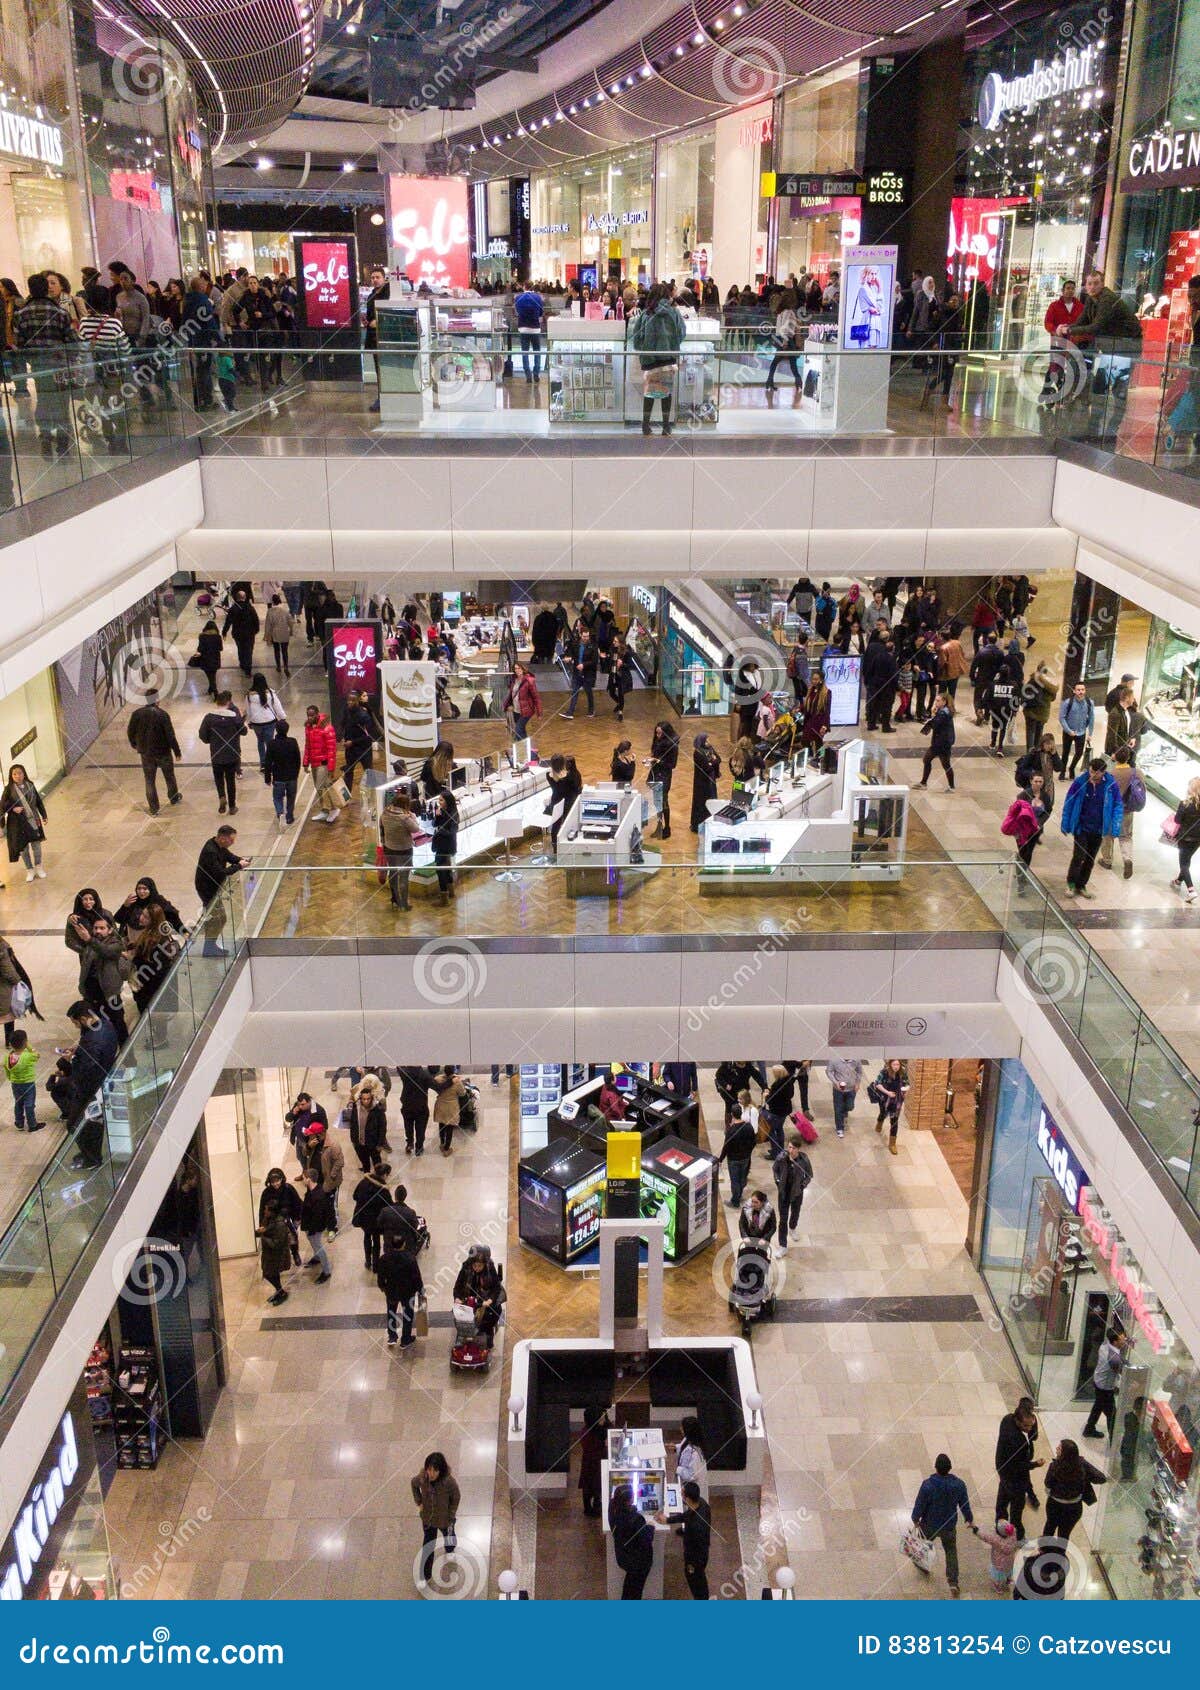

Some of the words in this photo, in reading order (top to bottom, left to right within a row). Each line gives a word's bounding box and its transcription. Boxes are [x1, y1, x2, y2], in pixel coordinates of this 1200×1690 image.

[1000, 59, 1060, 116] sunglass
[1063, 44, 1093, 92] hut
[869, 191, 904, 203] BROS.
[870, 177, 903, 189] MOSS
[522, 182, 530, 220] adidas
[392, 198, 469, 265] Sale
[303, 257, 349, 291] Sale
[333, 639, 376, 668] Sale
[994, 684, 1014, 694] NOT
[841, 1019, 883, 1029] CONCIERGE
[1037, 1109, 1078, 1206] kids
